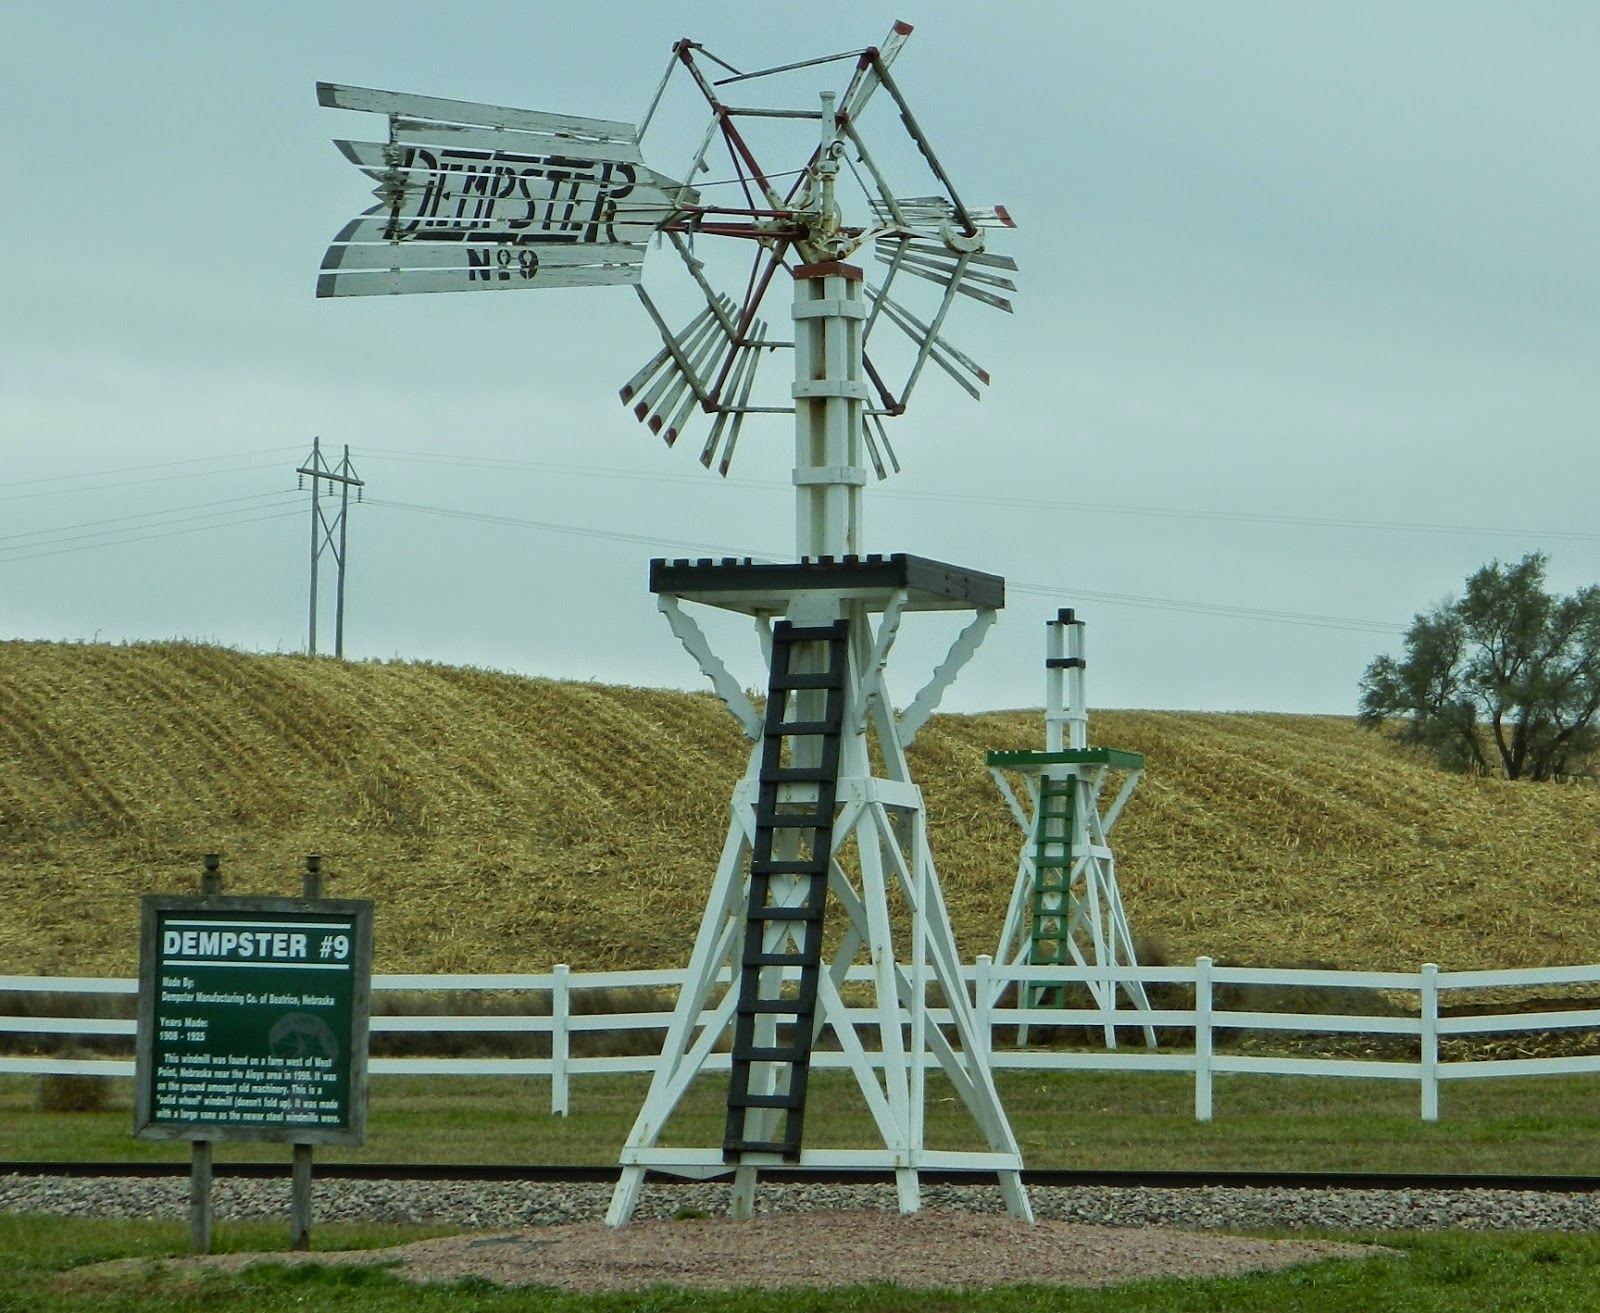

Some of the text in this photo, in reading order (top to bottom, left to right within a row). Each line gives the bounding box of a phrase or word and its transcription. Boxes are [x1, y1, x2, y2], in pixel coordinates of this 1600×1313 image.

[383, 148, 636, 243] DEMPSTER
[163, 931, 350, 959] DEMPSTER #9
[162, 977, 195, 989] Made By:
[161, 991, 335, 1007] Dempster Manufacturing Co. of Beatrice, Nebraska
[160, 1017, 208, 1028] Years Made:
[186, 1032, 206, 1042] 1925
[164, 1053, 332, 1067] This windmill was found on a farm west of West
[157, 1066, 178, 1078] Point,
[179, 1067, 213, 1078] Nebraska
[213, 1070, 230, 1079] near
[231, 1069, 244, 1079] the
[266, 1072, 283, 1080] area
[283, 1069, 292, 1080] in
[322, 1073, 338, 1082] was
[167, 1081, 180, 1091] the
[181, 1082, 206, 1093] ground
[206, 1083, 237, 1094] amongst
[238, 1083, 250, 1093] old
[251, 1083, 290, 1096] machinery.
[291, 1084, 307, 1095] This
[308, 1084, 316, 1095] is
[316, 1087, 323, 1095] a
[203, 1095, 234, 1106] windmill
[263, 1097, 278, 1108] fold
[302, 1101, 318, 1109] was
[319, 1100, 339, 1109] made
[156, 1108, 172, 1119] with
[173, 1111, 179, 1119] a
[180, 1109, 198, 1121] large
[218, 1112, 228, 1121] as
[228, 1110, 242, 1121] the
[265, 1112, 284, 1122] steel
[285, 1112, 319, 1123] windmills
